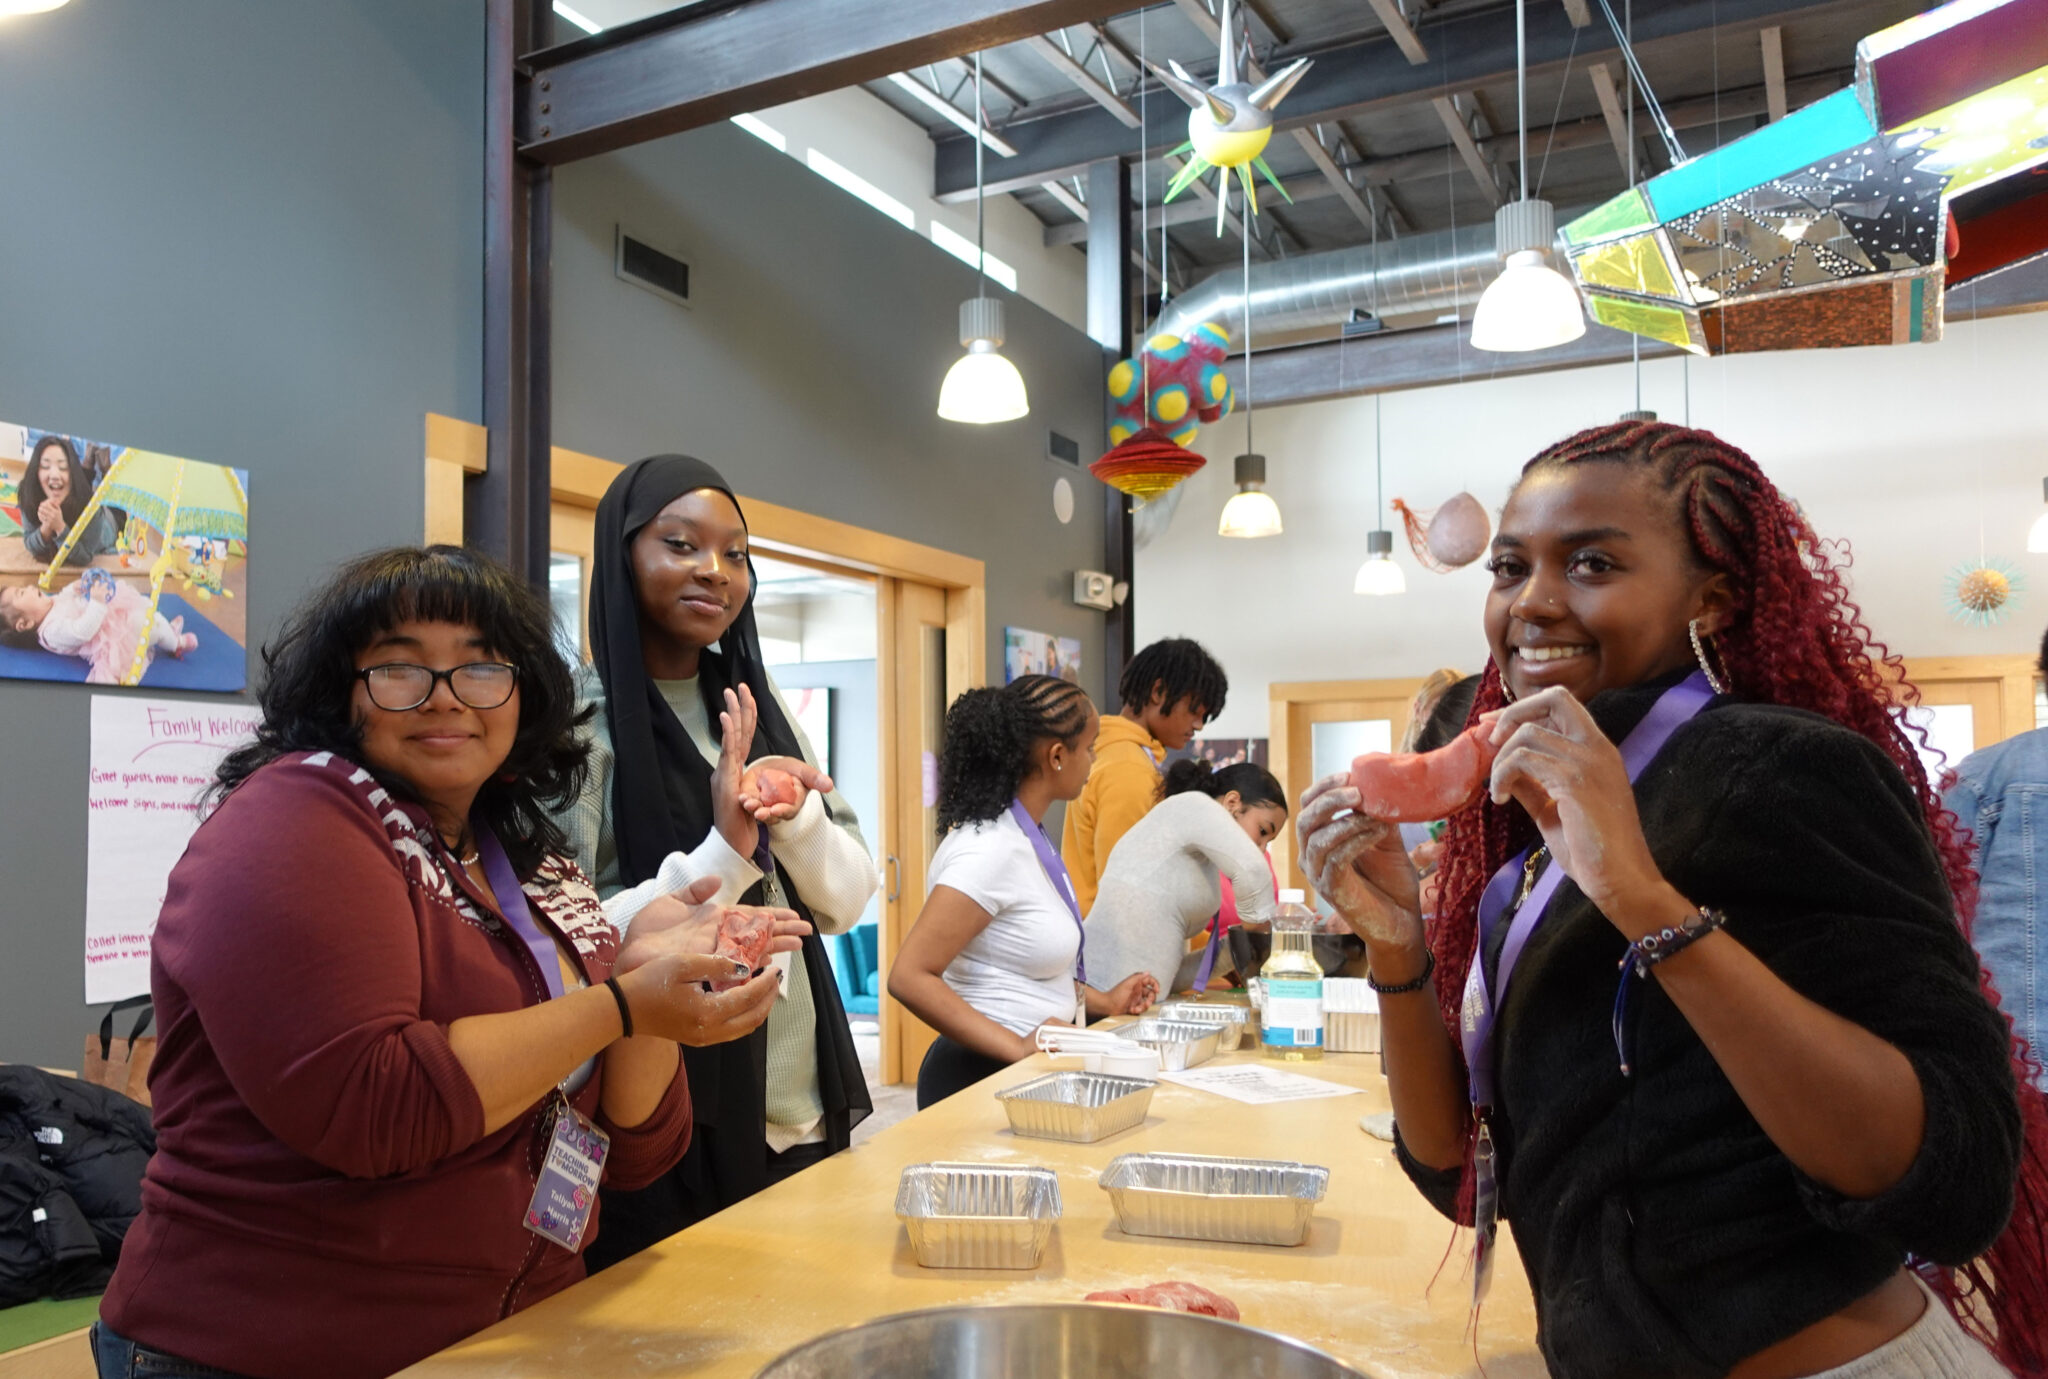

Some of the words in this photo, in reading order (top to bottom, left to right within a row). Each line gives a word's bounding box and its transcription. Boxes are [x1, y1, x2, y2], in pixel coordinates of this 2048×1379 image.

[146, 706, 202, 741] Family
[208, 716, 261, 737] Welcom
[89, 797, 128, 811] Welcome
[88, 935, 116, 949] Collect
[119, 933, 145, 944] intern
[554, 1145, 589, 1174] TEACHING
